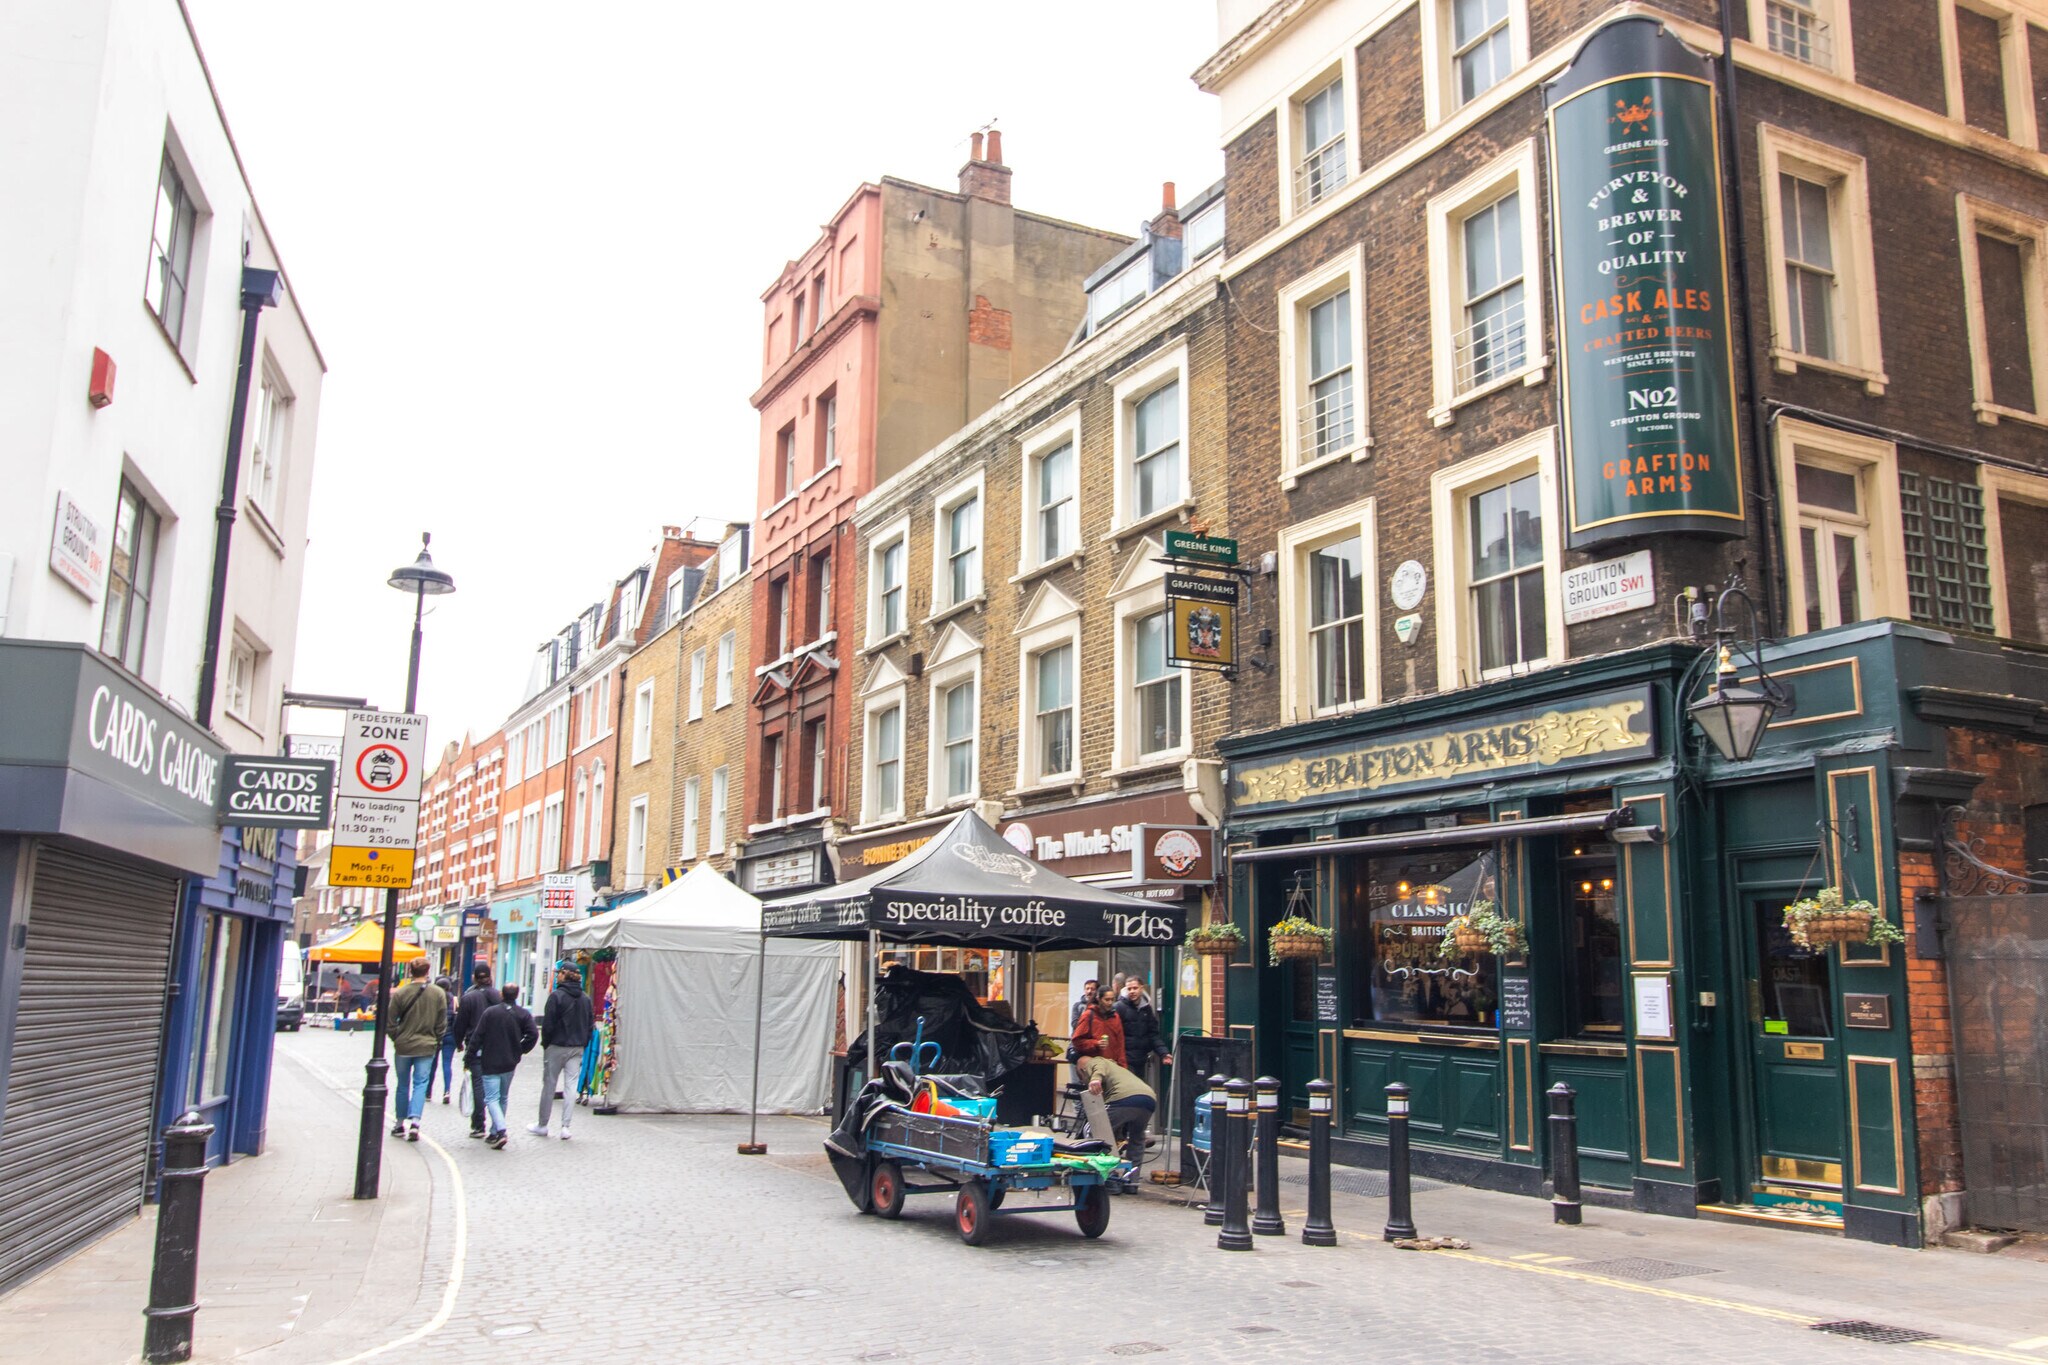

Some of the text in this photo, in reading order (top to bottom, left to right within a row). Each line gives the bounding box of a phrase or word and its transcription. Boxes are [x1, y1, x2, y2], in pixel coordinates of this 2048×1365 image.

[1604, 140, 1642, 154] GREENE
[1643, 139, 1669, 147] KING
[1587, 170, 1688, 210] PURVEYOR
[1631, 188, 1649, 204] &
[1597, 209, 1682, 232] BREWER
[1628, 231, 1655, 245] OF
[1598, 251, 1687, 274] QUALITY
[1580, 287, 1712, 325] CASK ALES
[1583, 326, 1713, 353] CRAFTED BEERS
[1603, 350, 1697, 367] WESTGATE BREWERY
[1626, 357, 1675, 369] SINCE 1799
[1609, 412, 1702, 428] STRUTTON GROUND
[1636, 424, 1674, 433] VICTORIA
[1602, 452, 1710, 480] GRAFTON
[1625, 474, 1692, 498] ARMS
[1174, 539, 1208, 552] GREENE
[1209, 544, 1232, 555] KING
[1568, 561, 1627, 589] STRUTTON
[1171, 579, 1235, 596] GRAFTON ARMS
[1569, 574, 1645, 606] GROUND SW1
[352, 713, 422, 726] PEDESTRIAN
[360, 725, 410, 741] ZONE
[88, 685, 218, 807] CARDS GALORE
[1305, 721, 1537, 790] GRAFTON ARMS
[238, 769, 318, 793] CARDS
[229, 791, 323, 814] GALORE
[351, 801, 405, 813] No loading
[353, 813, 397, 824] Mon Fri
[341, 824, 385, 834] 11.30 am
[368, 835, 410, 846] 2.30 pm
[1035, 835, 1064, 861] The
[1063, 828, 1111, 858] Whole
[351, 863, 395, 873] Mon Fri
[335, 873, 407, 885] 7 am 6.30 pm
[548, 875, 574, 885] TO LET
[544, 890, 575, 899] STRIPE
[544, 900, 575, 908] STREET
[797, 898, 822, 924] coffee
[1391, 902, 1468, 918] CLASSIC
[886, 896, 1174, 941] speciality coffee by notes
[1411, 926, 1448, 936] BRITISH
[1391, 942, 1420, 958] PUB
